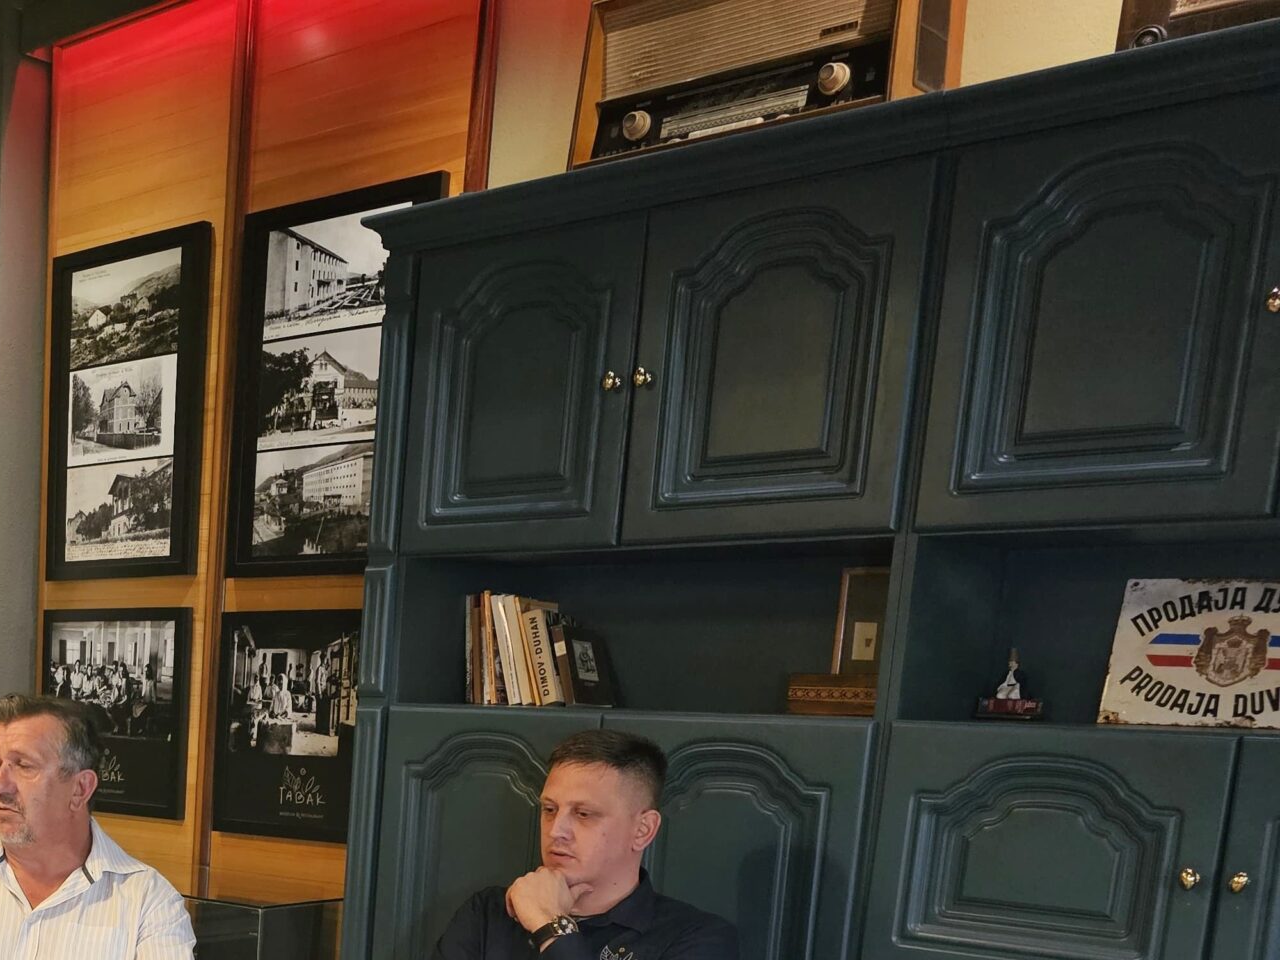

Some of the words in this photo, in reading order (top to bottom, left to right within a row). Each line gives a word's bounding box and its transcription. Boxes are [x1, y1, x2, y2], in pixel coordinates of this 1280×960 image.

[1130, 586, 1248, 637] ПРОДАЈА
[528, 616, 543, 656] DUHAN
[537, 661, 550, 698] DIMOV
[1119, 665, 1221, 718] PRODAJA
[101, 770, 128, 784] BAK
[279, 786, 328, 807] TABAK
